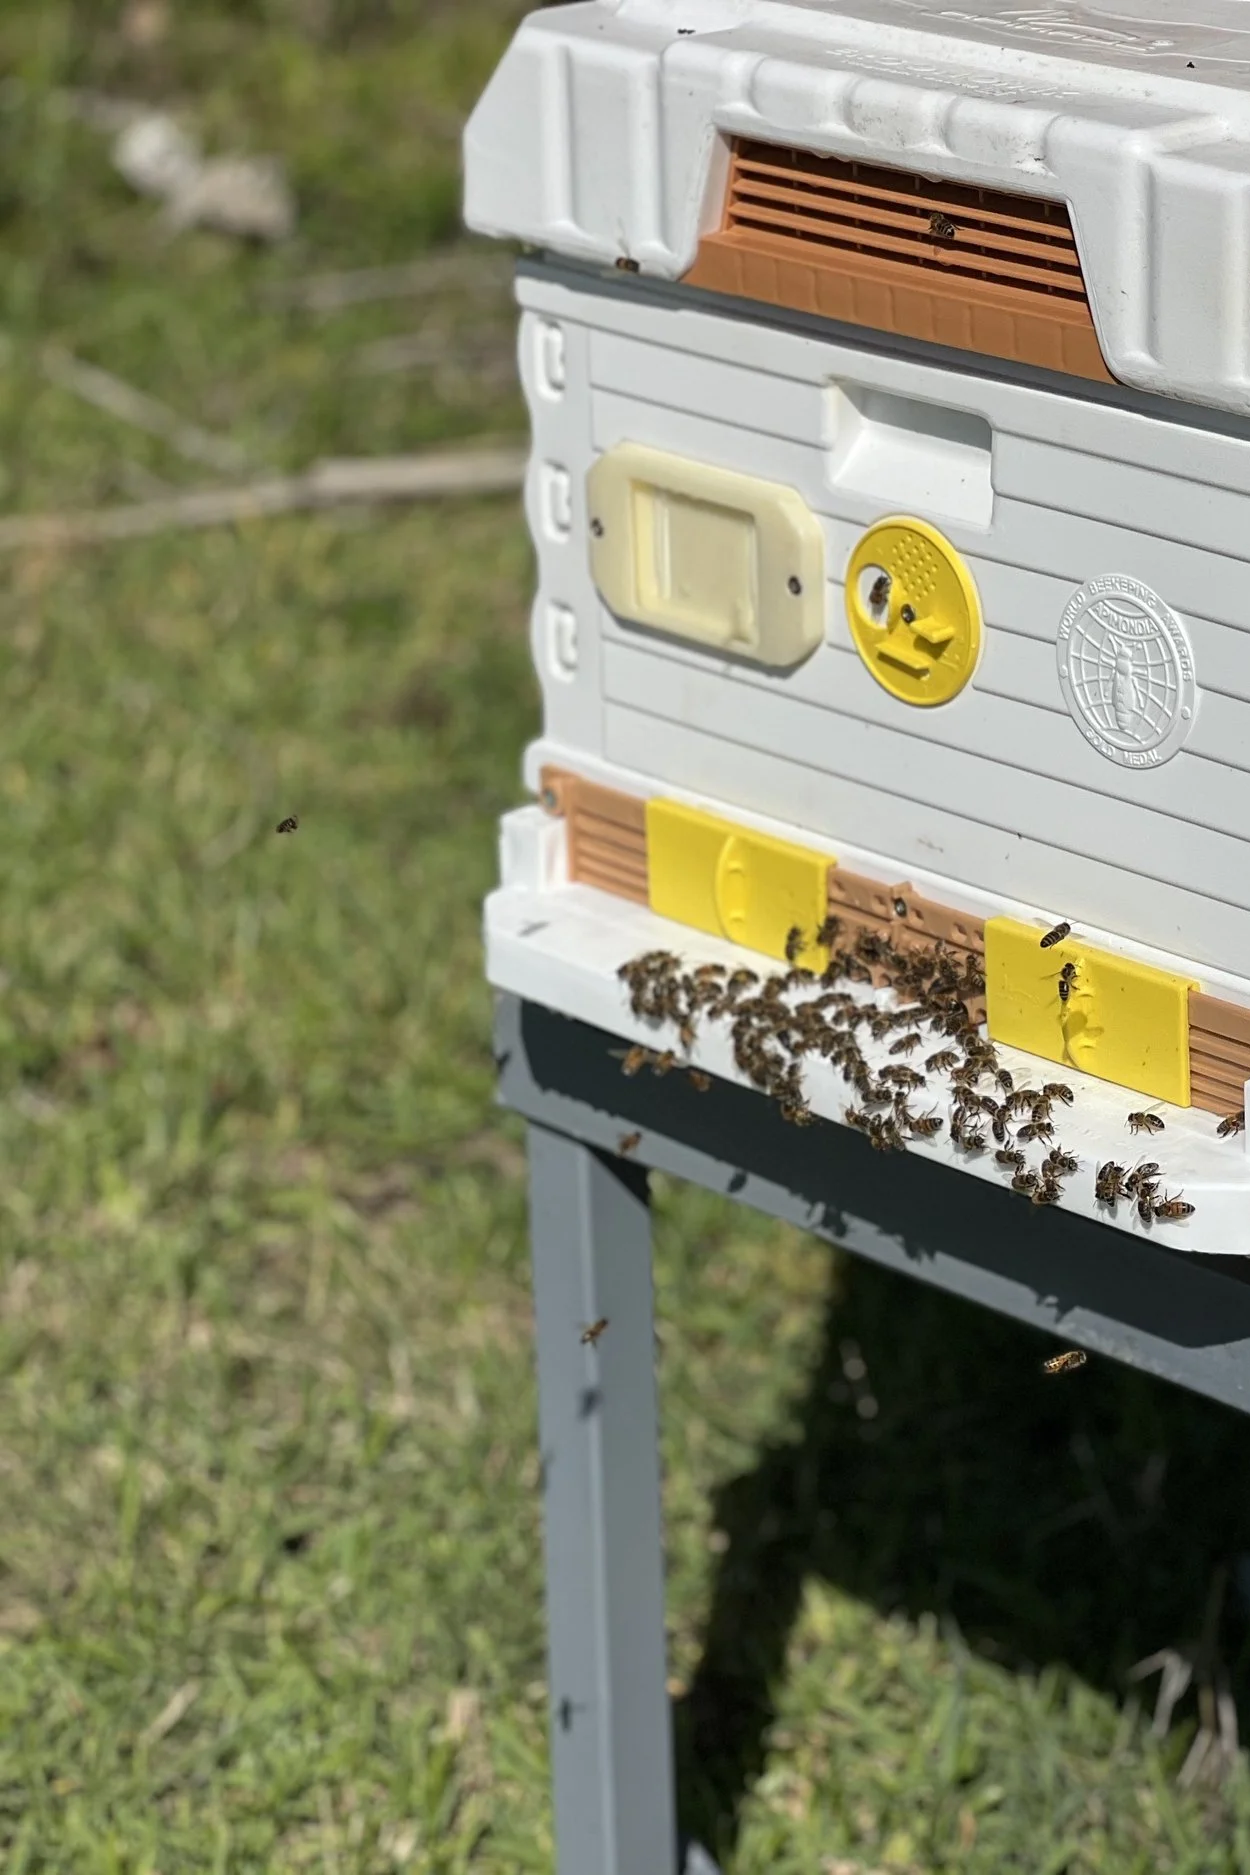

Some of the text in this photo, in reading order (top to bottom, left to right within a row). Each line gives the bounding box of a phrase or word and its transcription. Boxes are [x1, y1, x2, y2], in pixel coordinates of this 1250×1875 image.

[1059, 591, 1087, 641] WORLD
[1094, 601, 1160, 637] APIMONDIA
[1086, 727, 1163, 766] GOLD MEDAL
